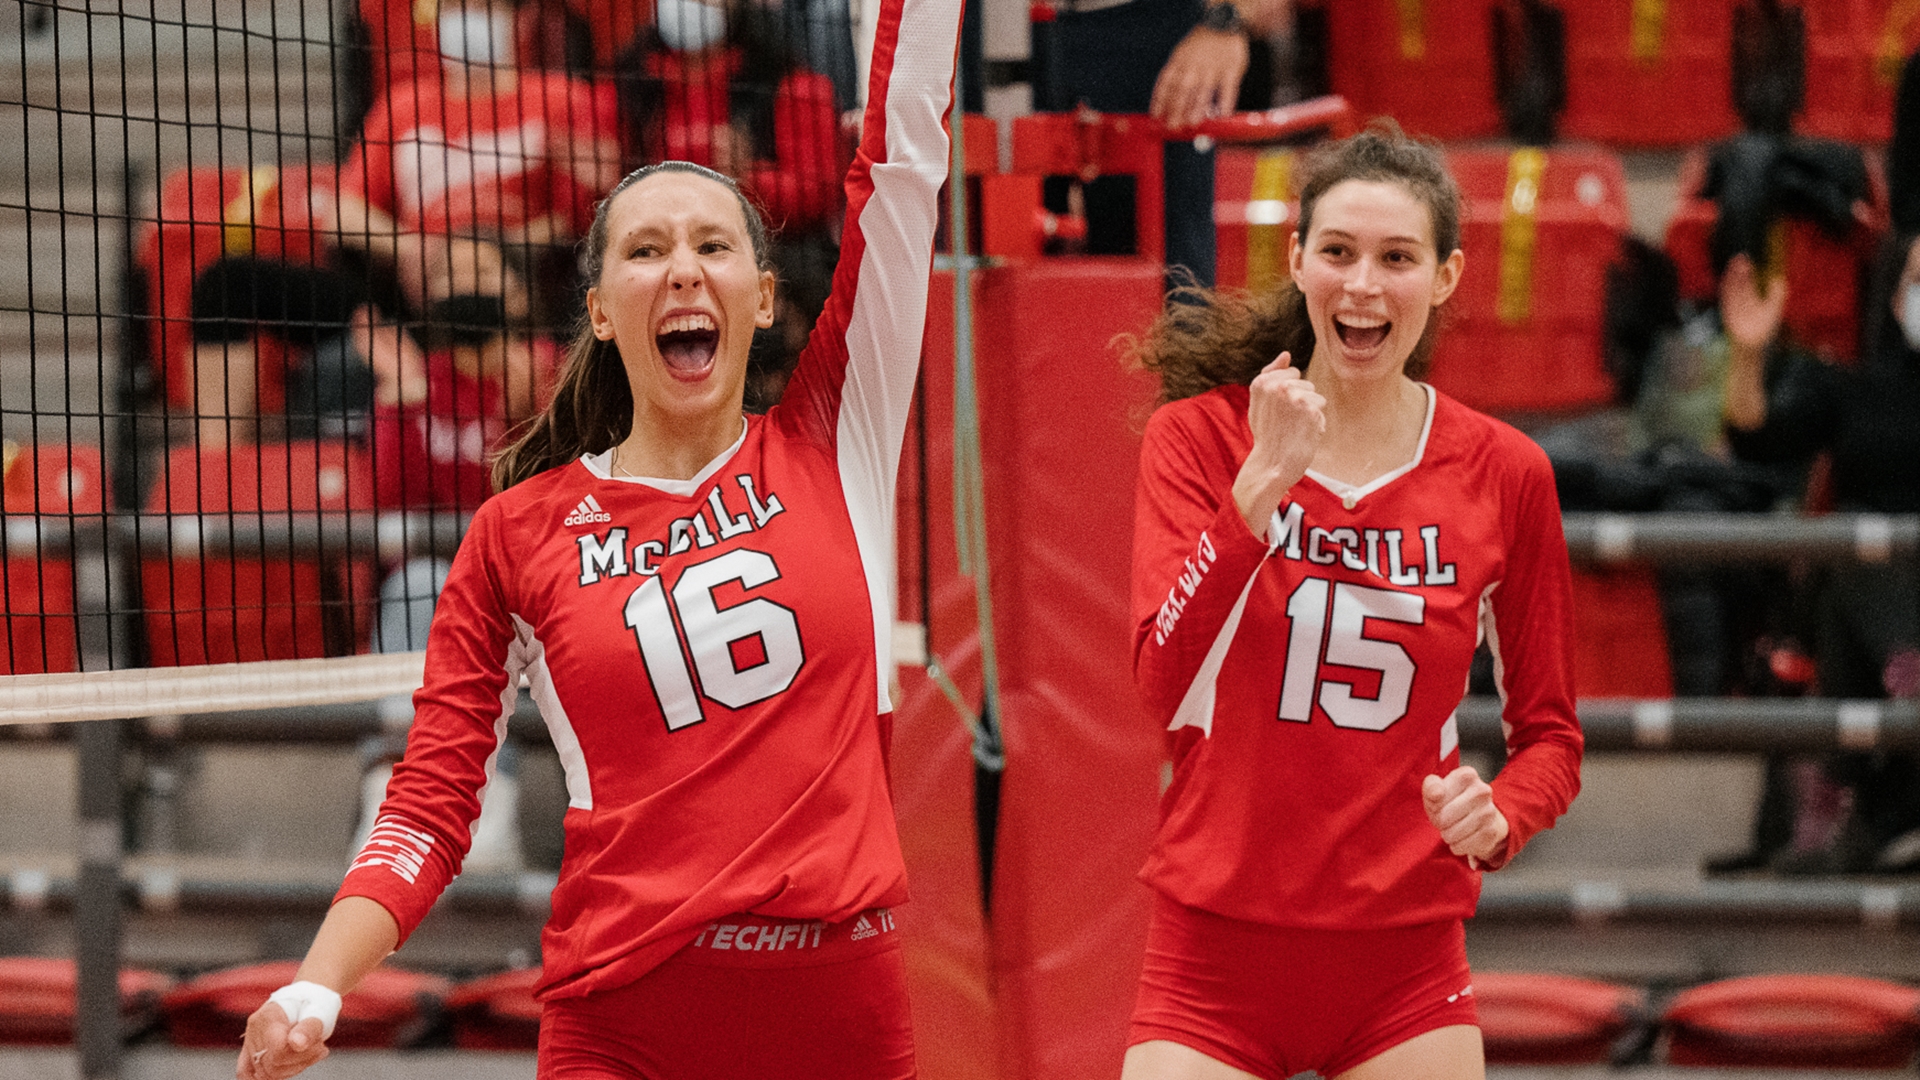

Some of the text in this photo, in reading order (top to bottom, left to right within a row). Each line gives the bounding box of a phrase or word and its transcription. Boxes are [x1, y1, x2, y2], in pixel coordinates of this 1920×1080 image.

[564, 510, 611, 526] adidas
[622, 547, 806, 734] 16
[1277, 576, 1425, 732] 15
[694, 922, 828, 951] TECHFIT
[851, 928, 879, 941] adidas
